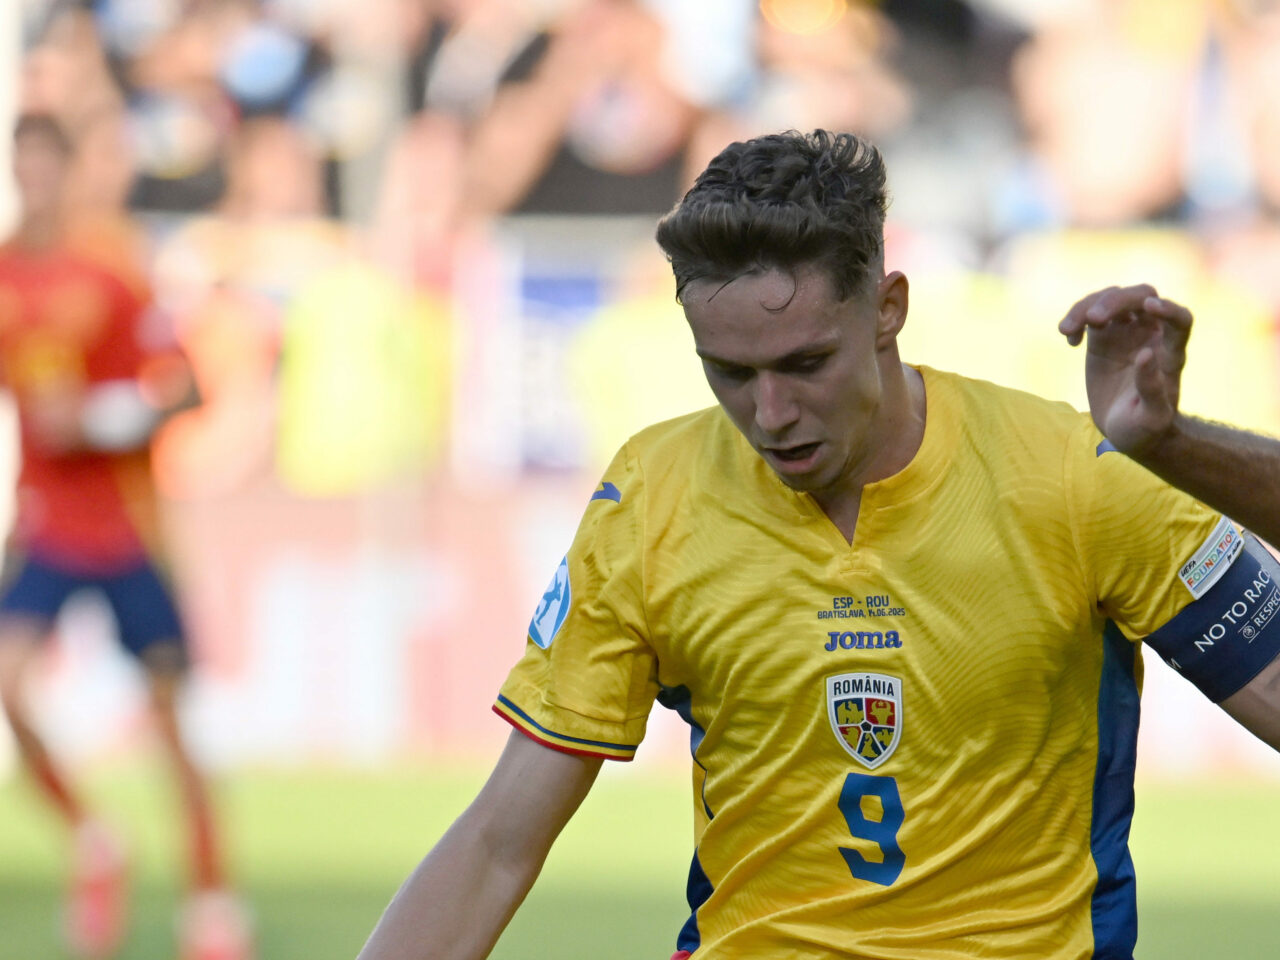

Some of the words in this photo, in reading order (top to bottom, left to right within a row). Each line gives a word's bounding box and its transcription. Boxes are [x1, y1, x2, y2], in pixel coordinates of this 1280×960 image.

[1186, 527, 1236, 588] FOUNDATION
[817, 609, 867, 619] BRATISLAVA,
[833, 596, 854, 610] ESP
[866, 594, 890, 608] ROU
[1194, 624, 1226, 653] NO
[1222, 601, 1248, 624] TO
[833, 675, 895, 697] ROMÂNIA
[838, 772, 906, 887] 9
